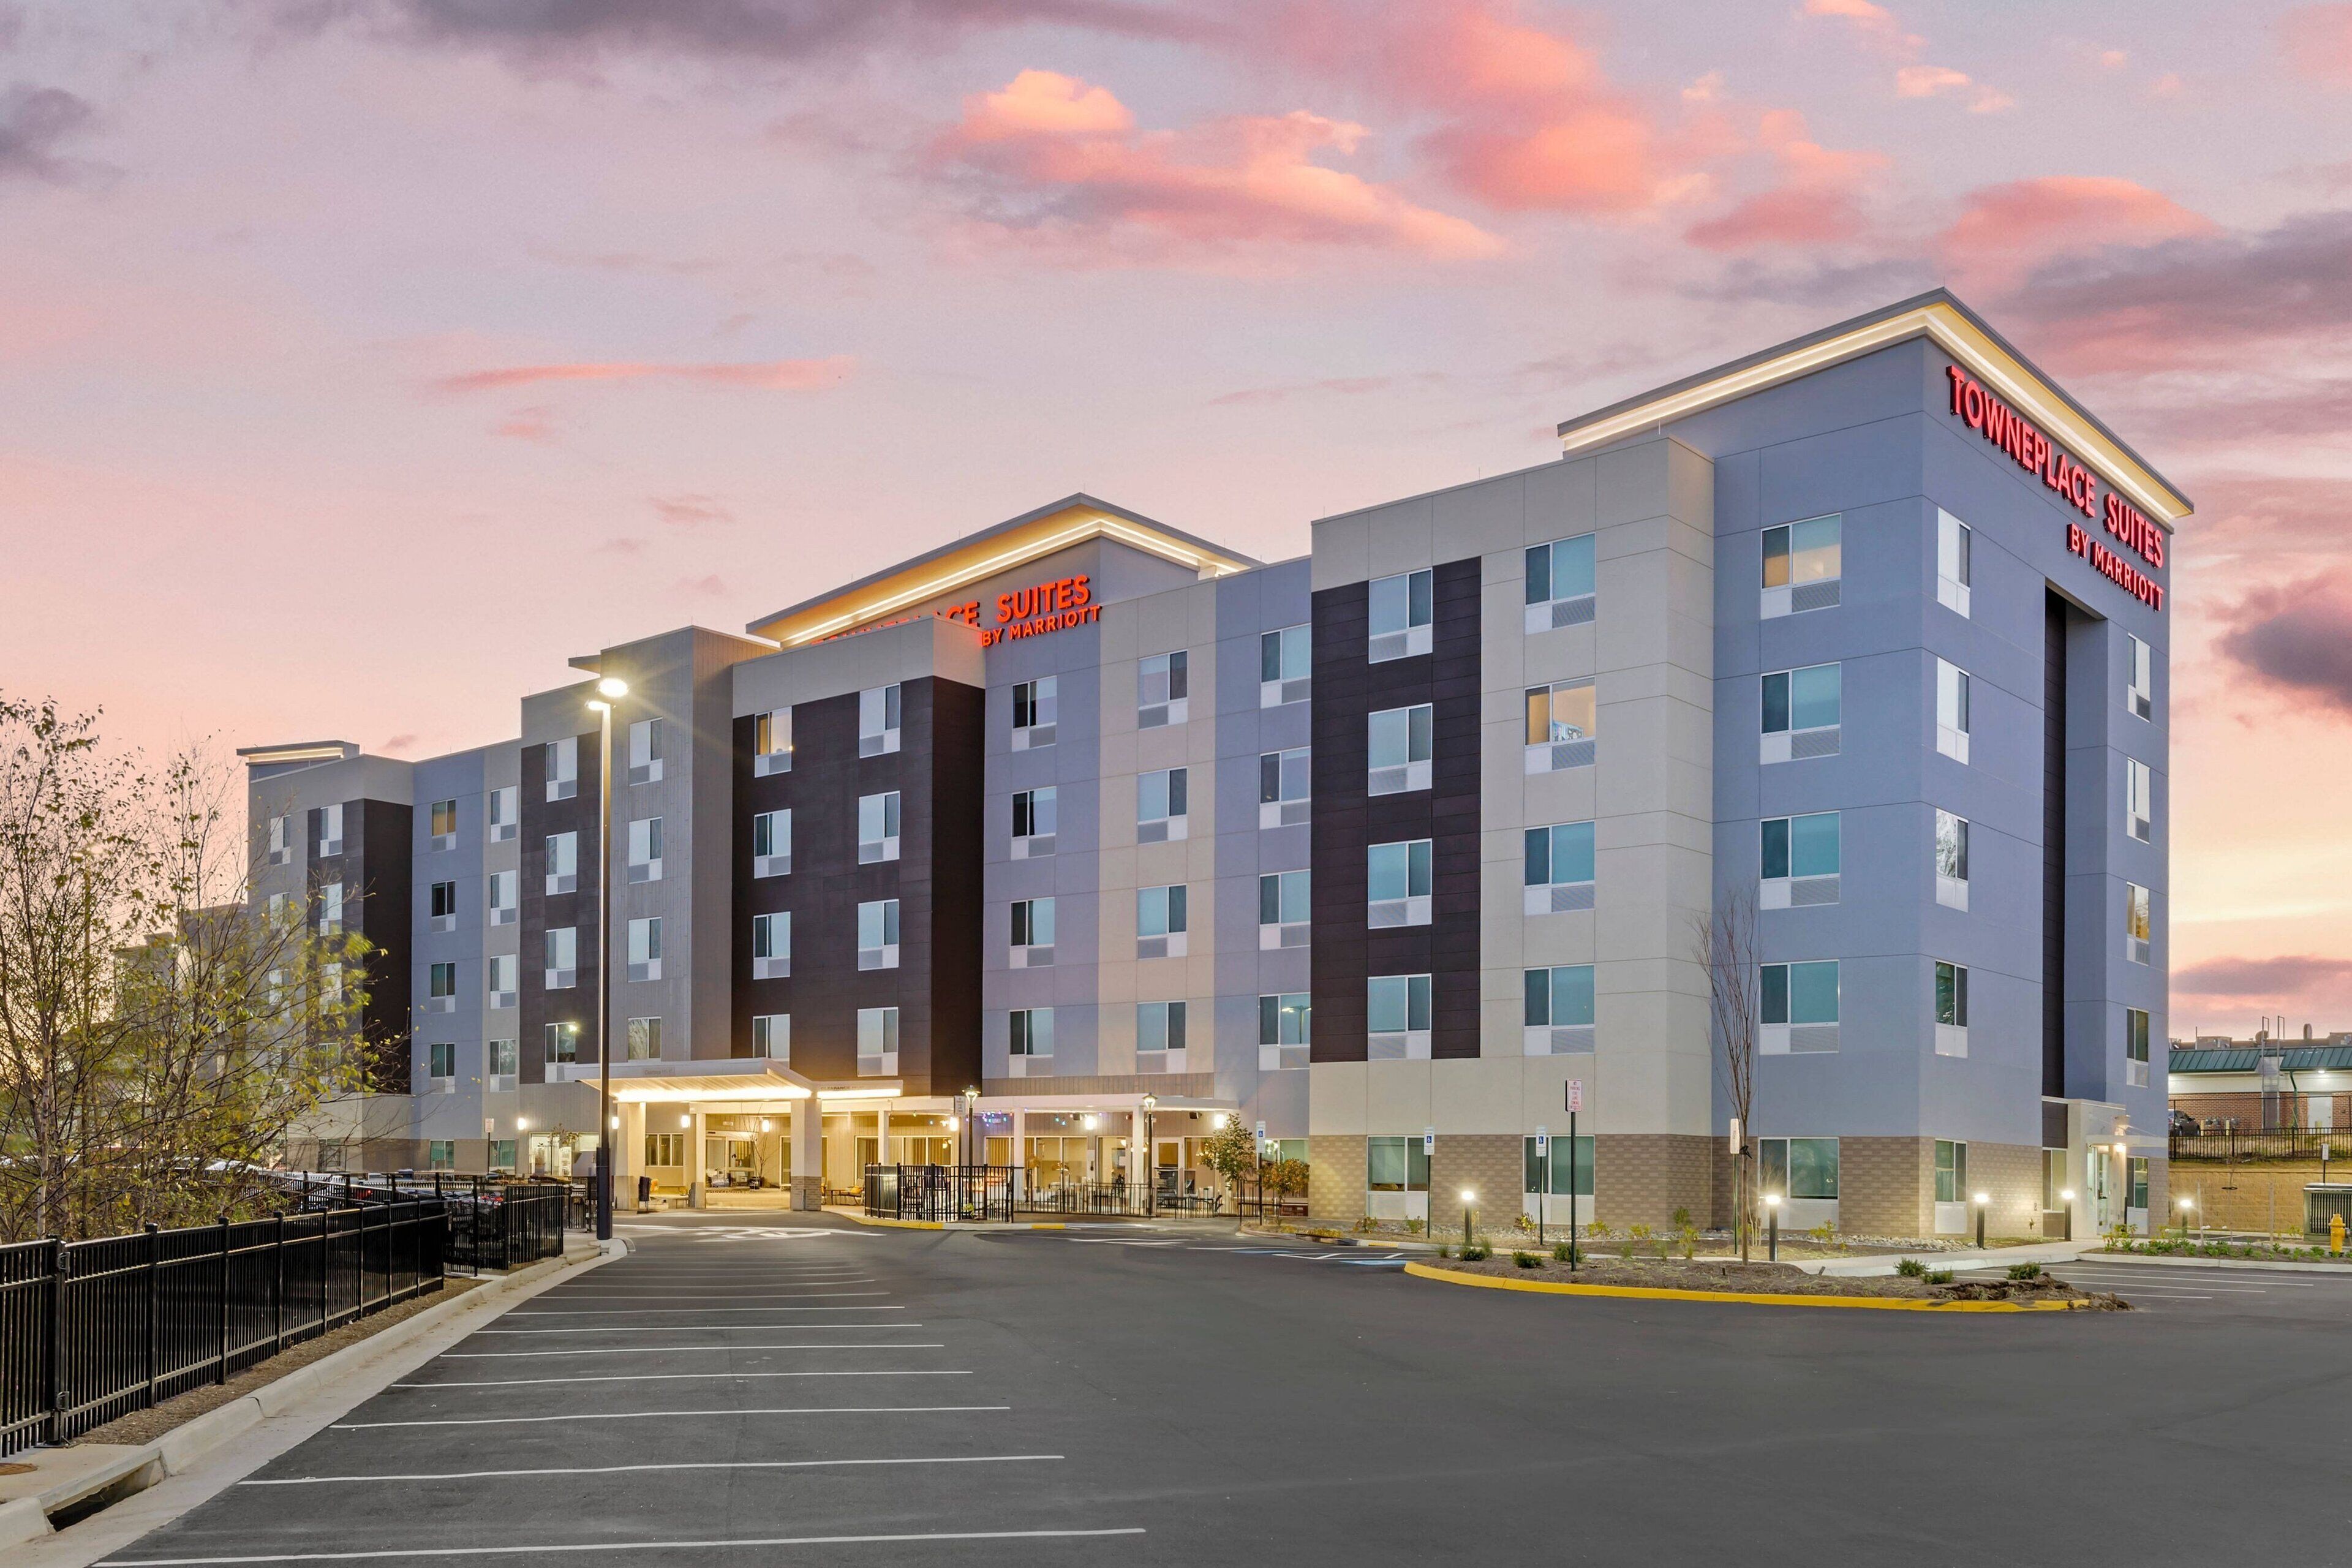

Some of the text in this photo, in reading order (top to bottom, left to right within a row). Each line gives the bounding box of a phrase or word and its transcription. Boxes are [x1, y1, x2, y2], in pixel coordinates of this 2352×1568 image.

[1947, 365, 2163, 568] TOWNEPLACE SUITES
[997, 574, 1091, 623] SUITES
[2067, 522, 2163, 612] BY MARRIOTT
[981, 628, 1005, 646] BY
[1009, 604, 1102, 641] MARRIOTT
